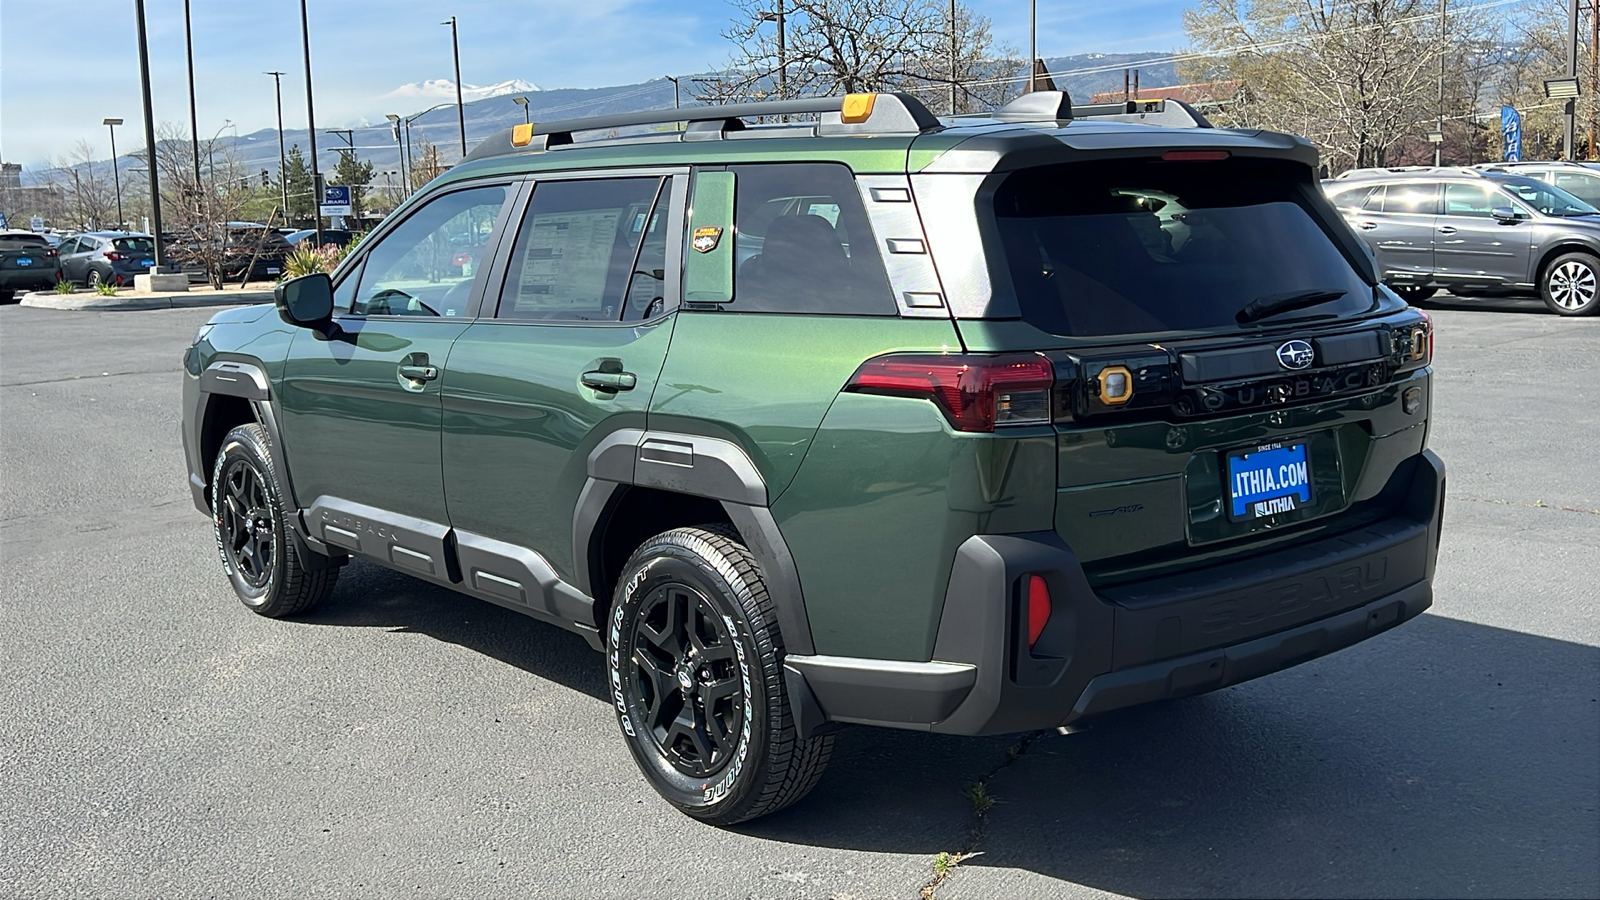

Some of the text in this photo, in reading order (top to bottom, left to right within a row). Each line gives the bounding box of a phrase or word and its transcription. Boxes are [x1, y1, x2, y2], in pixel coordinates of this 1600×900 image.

[1203, 372, 1382, 410] OUTBACK
[1257, 444, 1271, 452] SINCE
[1231, 461, 1308, 498] LITHIA.COM
[1263, 496, 1296, 516] LITHIA
[320, 509, 399, 542] OUTBACK
[1202, 556, 1388, 635] SUBARU
[609, 565, 649, 738] DUELER A/T
[703, 614, 753, 803] BRIDGESTONE
